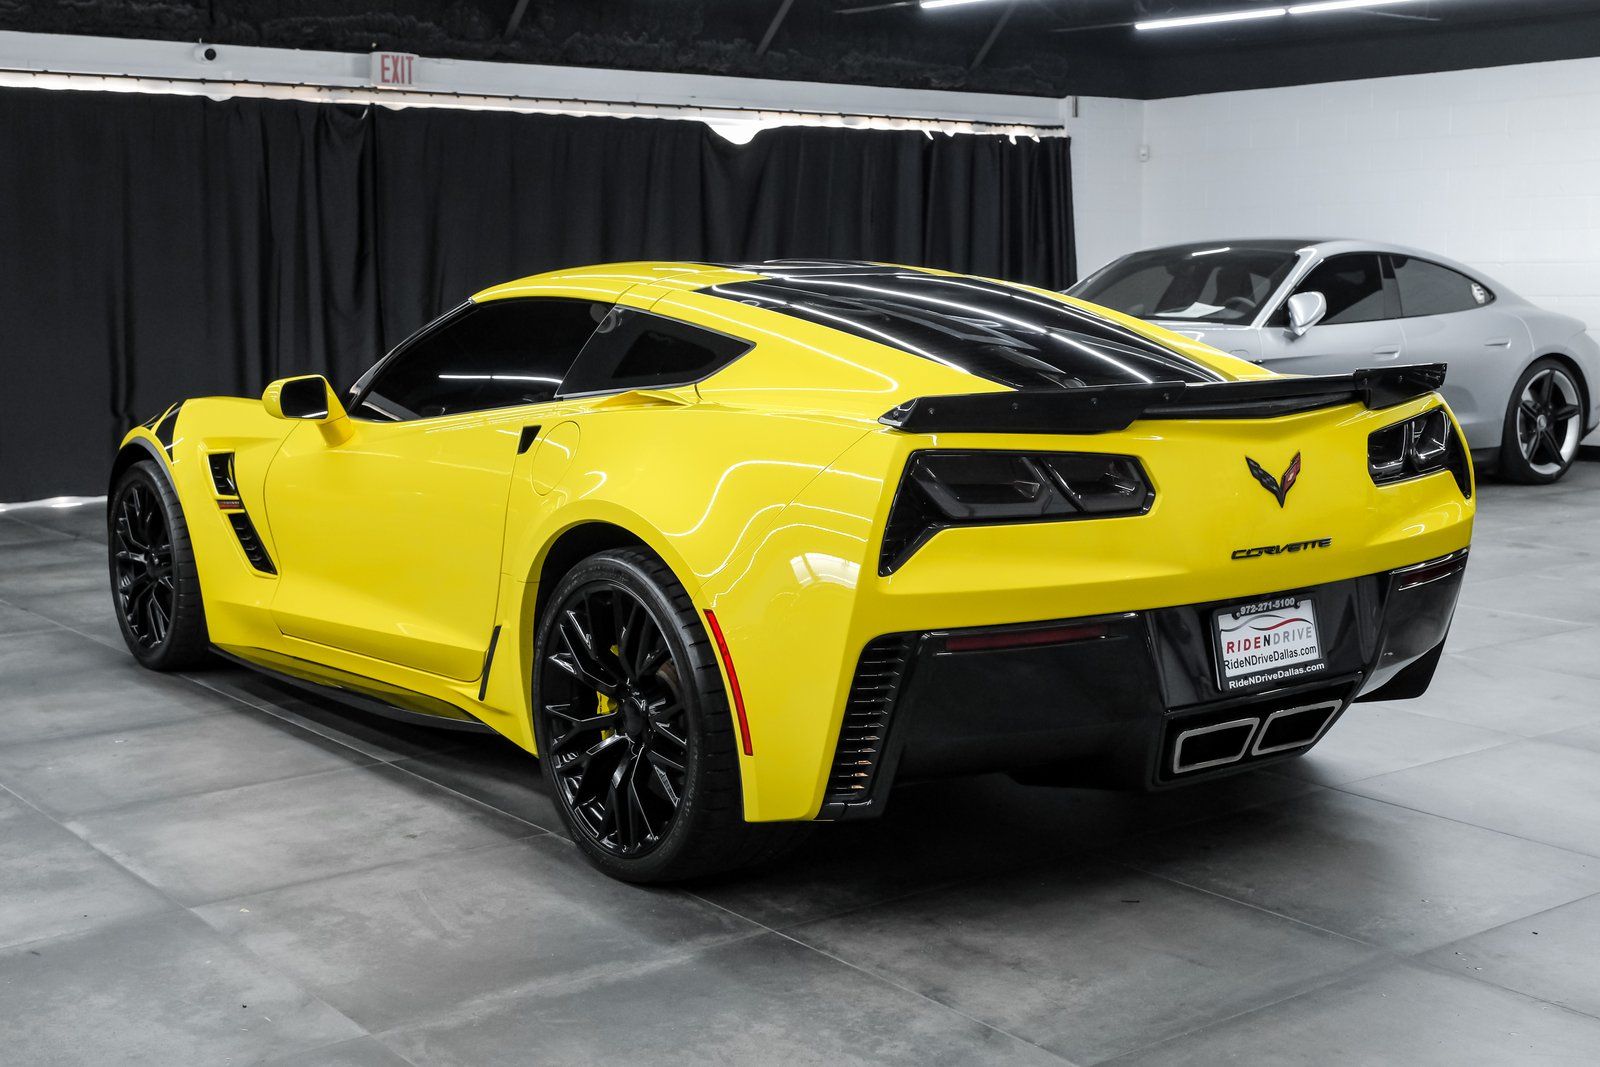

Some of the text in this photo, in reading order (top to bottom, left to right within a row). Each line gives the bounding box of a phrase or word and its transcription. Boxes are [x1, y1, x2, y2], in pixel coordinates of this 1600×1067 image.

[381, 54, 414, 84] EXIT
[1231, 538, 1332, 560] CORVETTE
[1240, 597, 1295, 615] 972-271-5100
[1226, 626, 1312, 654] RIDENDRIVE
[1224, 645, 1317, 670] RideNDriveDallas.com
[1229, 662, 1325, 689] RideNDriveDallas.com
